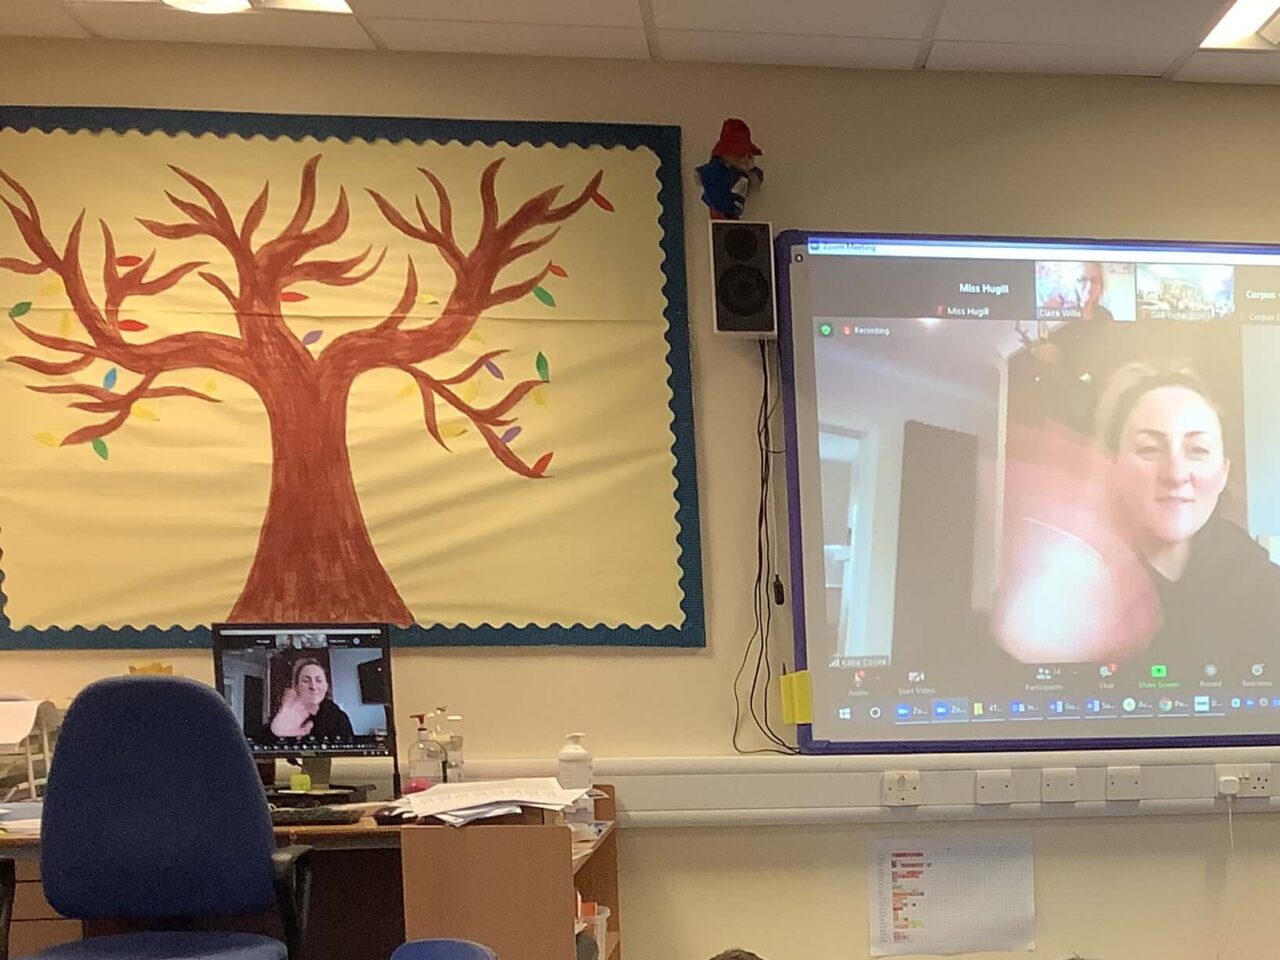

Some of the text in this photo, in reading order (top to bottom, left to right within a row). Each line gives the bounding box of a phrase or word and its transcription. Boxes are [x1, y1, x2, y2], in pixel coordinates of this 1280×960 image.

[959, 282, 1009, 296] Miss Hugill
[1246, 289, 1276, 302] Corpus
[947, 307, 990, 318] Miss Hugill
